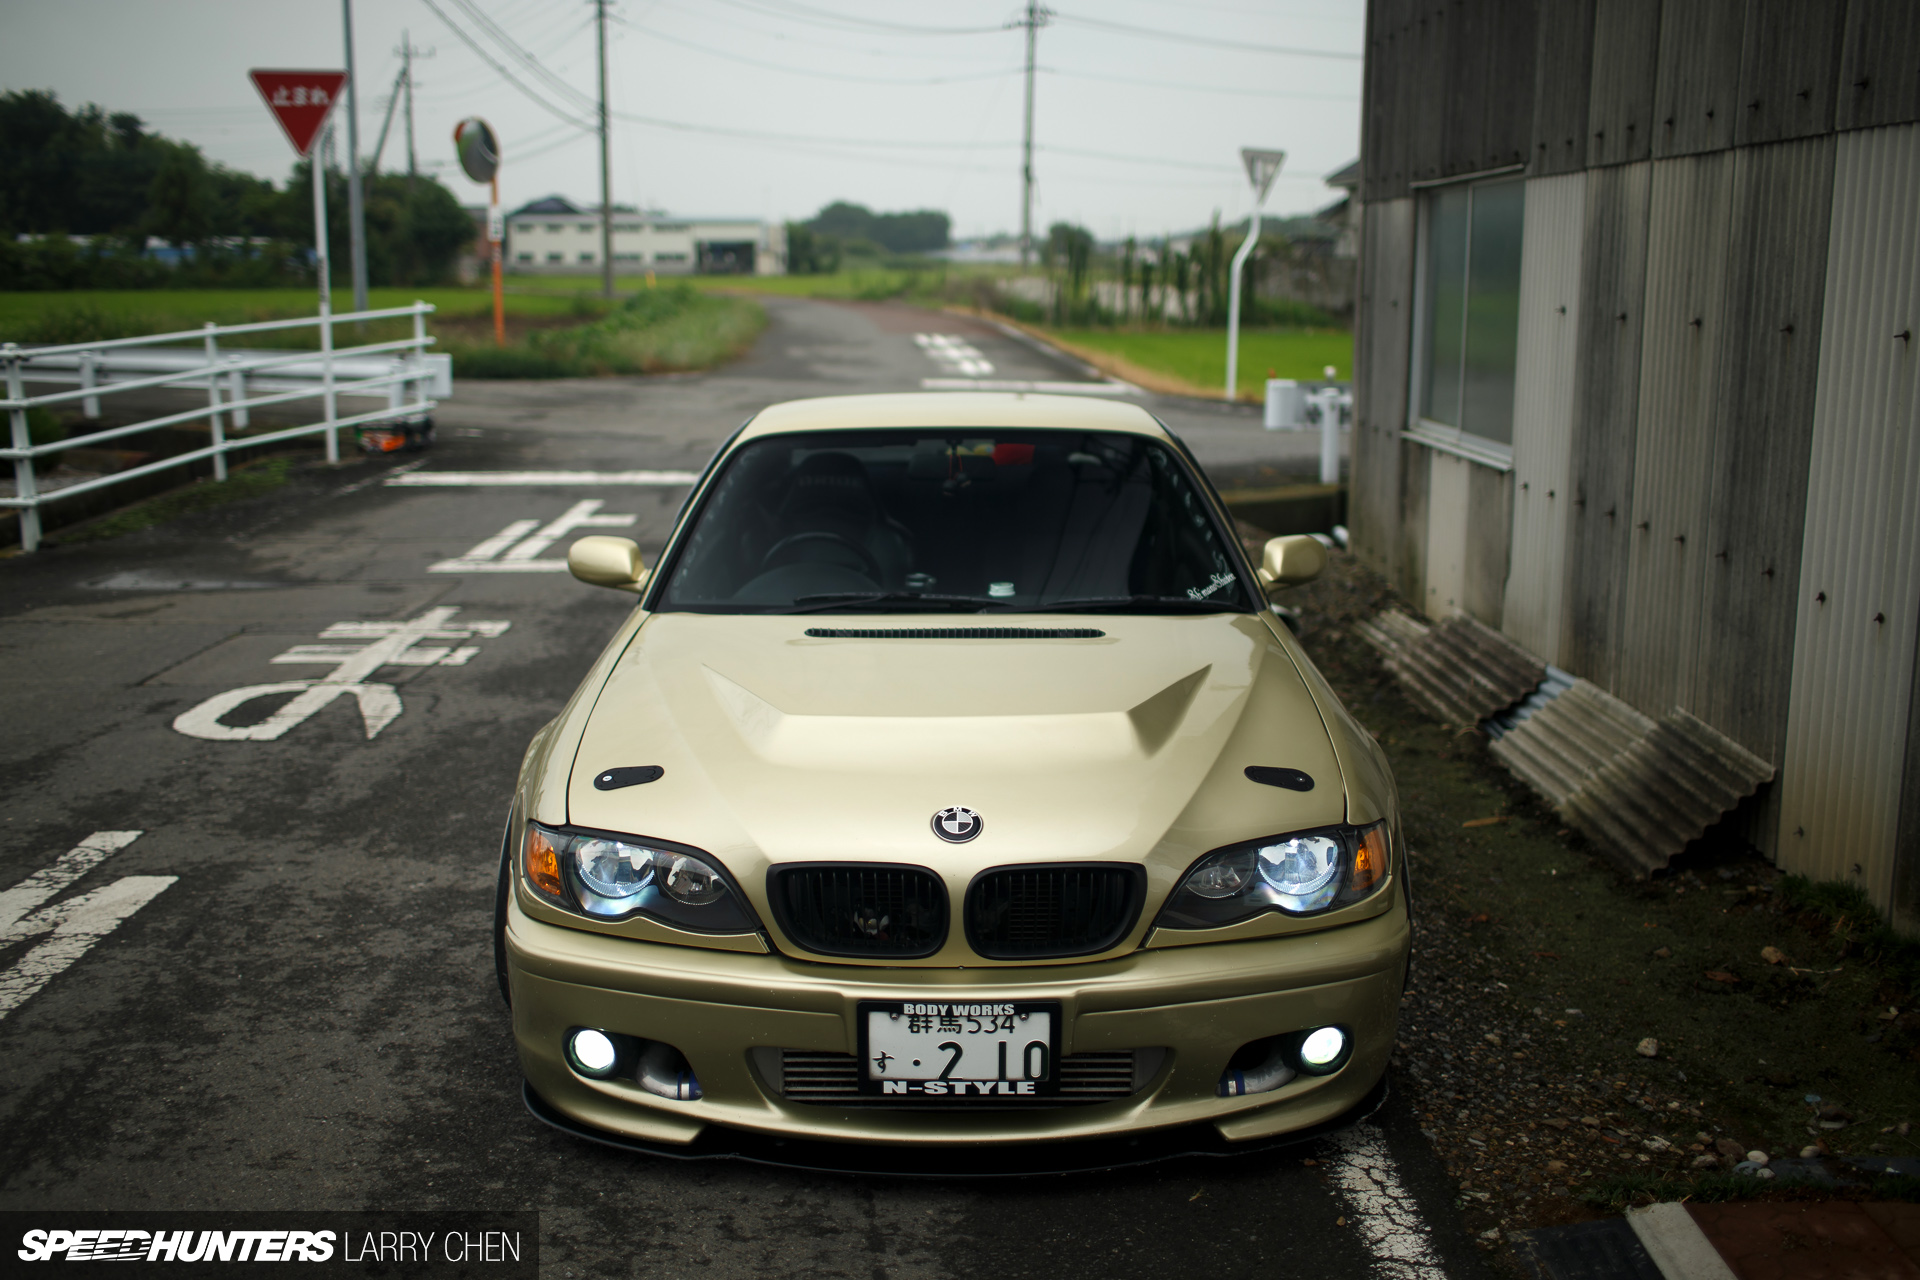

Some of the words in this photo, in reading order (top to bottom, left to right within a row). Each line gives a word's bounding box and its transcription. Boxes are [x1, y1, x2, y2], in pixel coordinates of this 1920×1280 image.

[272, 84, 329, 107] 止まれ
[938, 806, 978, 817] BMW
[903, 1003, 948, 1016] BODY
[952, 1004, 1015, 1016] WORKS
[872, 1050, 895, 1073] す
[883, 1080, 1036, 1095] N-STYLE
